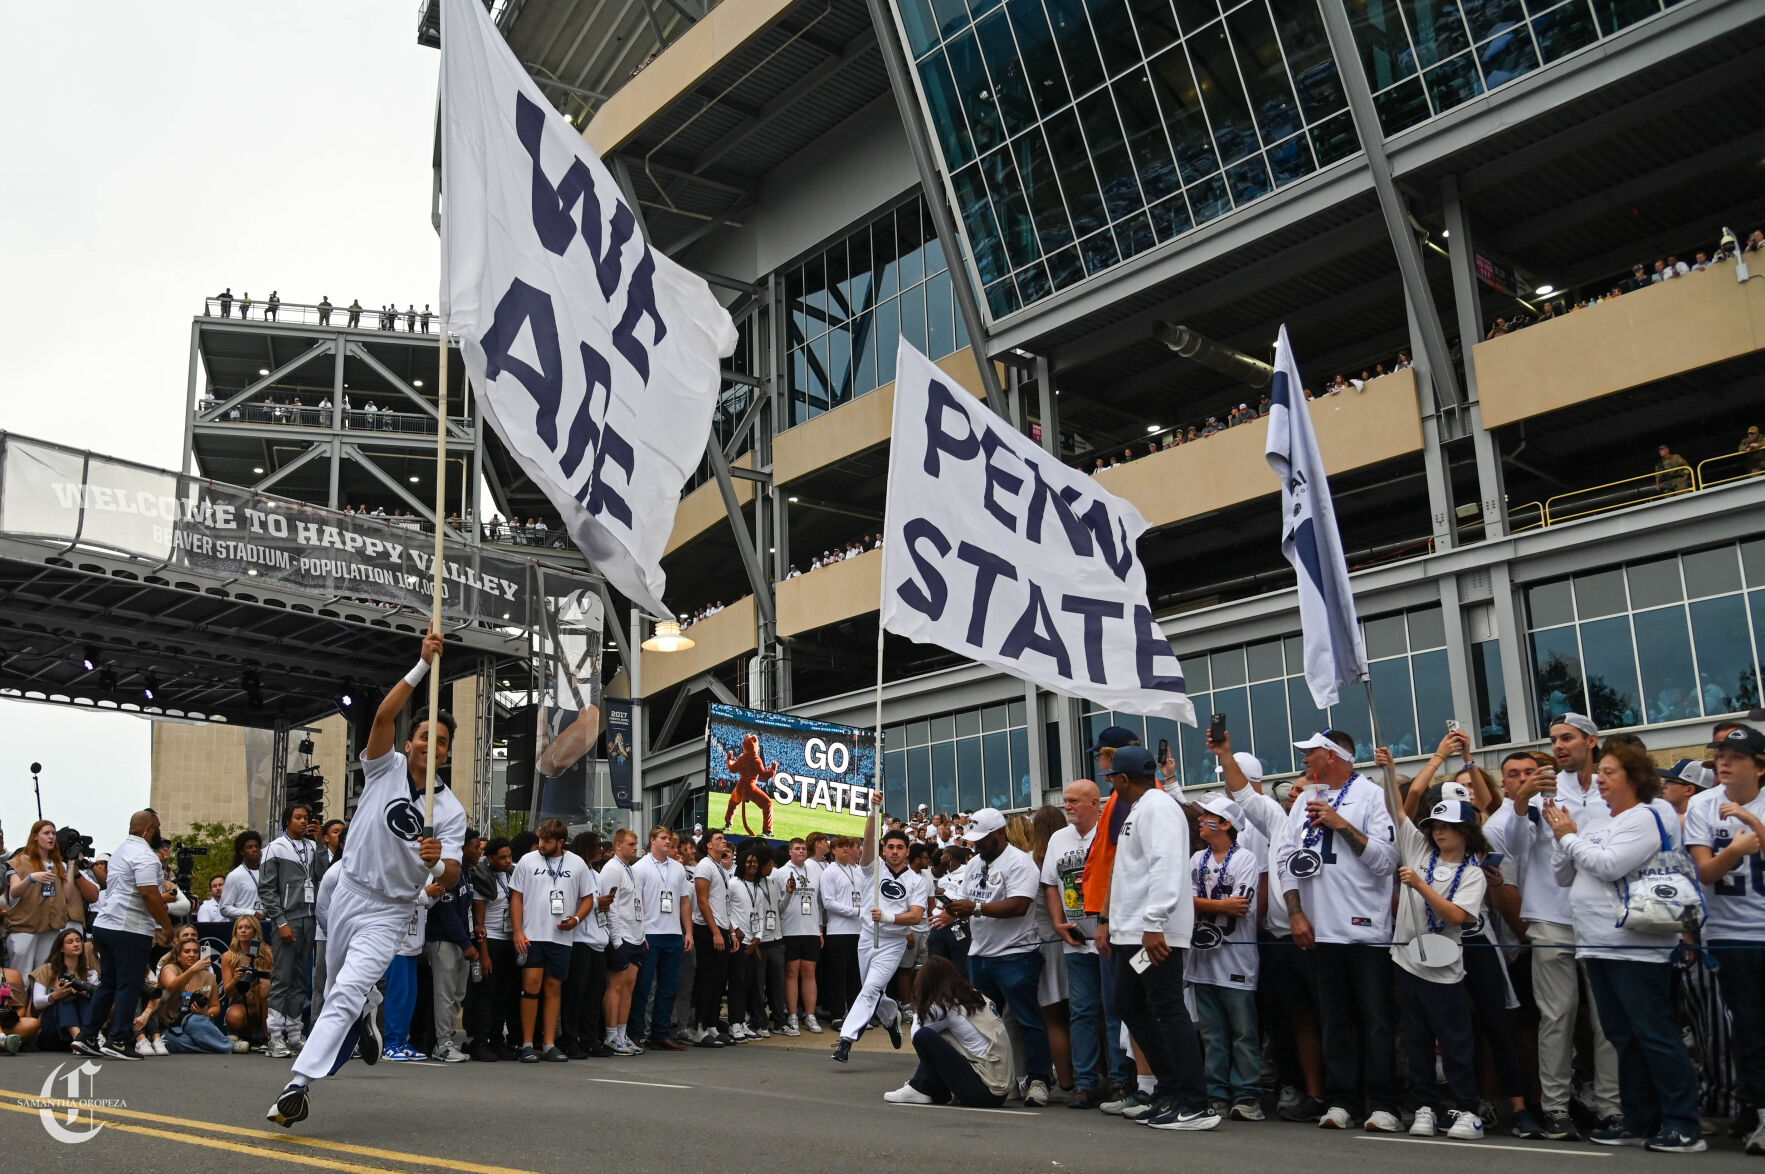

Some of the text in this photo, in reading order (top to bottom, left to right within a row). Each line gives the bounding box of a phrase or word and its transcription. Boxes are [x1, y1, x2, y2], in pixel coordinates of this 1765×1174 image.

[515, 90, 668, 389] WE
[480, 277, 635, 530] ARE
[923, 378, 1133, 583] PENN
[51, 482, 519, 602] WELCOME TO HAPPY VALLEY
[153, 524, 213, 556] BEAVER
[216, 540, 290, 570] STADIUM
[300, 557, 395, 587] POPULATION
[896, 517, 1187, 694] STATE
[610, 710, 628, 719] 2017
[804, 737, 849, 774] GO
[1638, 866, 1681, 878] HALLS
